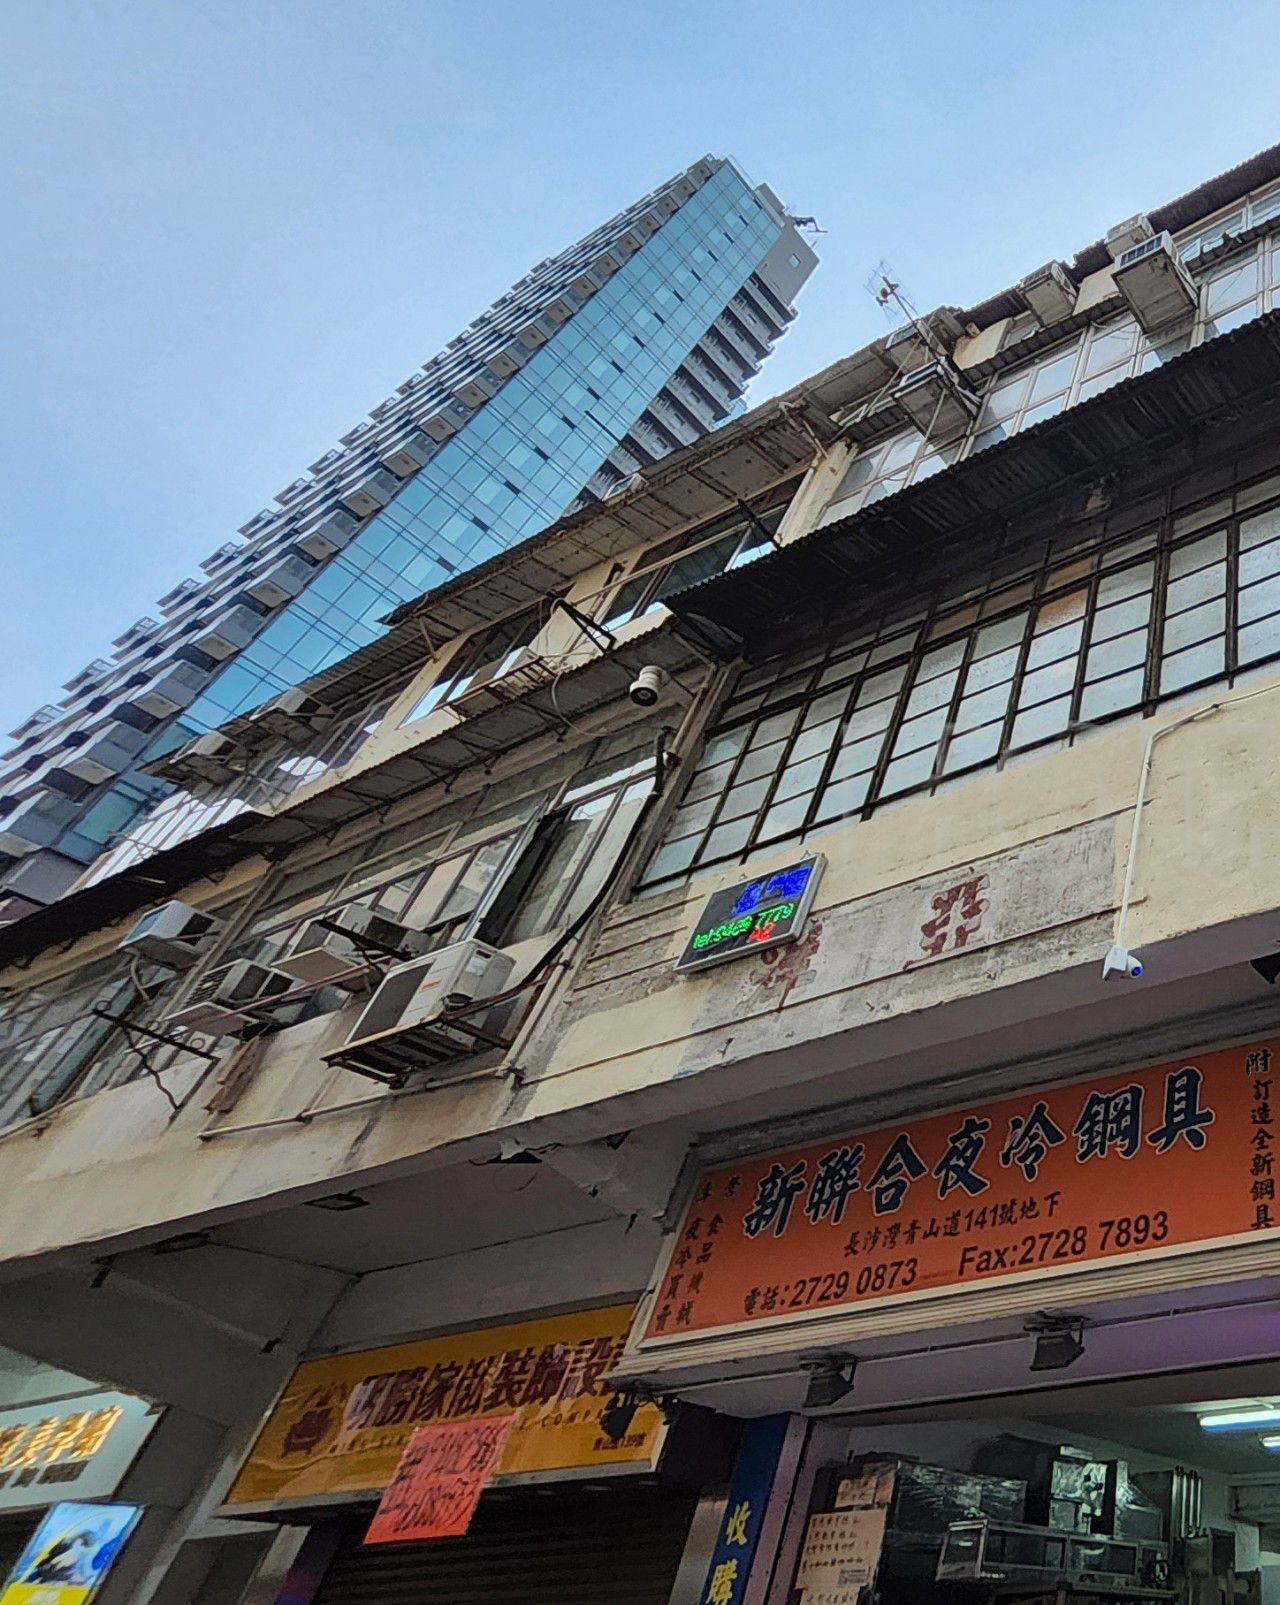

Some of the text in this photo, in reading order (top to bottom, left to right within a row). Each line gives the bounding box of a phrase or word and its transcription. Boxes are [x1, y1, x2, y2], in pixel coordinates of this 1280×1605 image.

[743, 1066, 1216, 1239] 新聯合夜冷鋼具
[856, 1257, 918, 1295] 0873
[956, 1210, 1170, 1278] Fax:2728 7893
